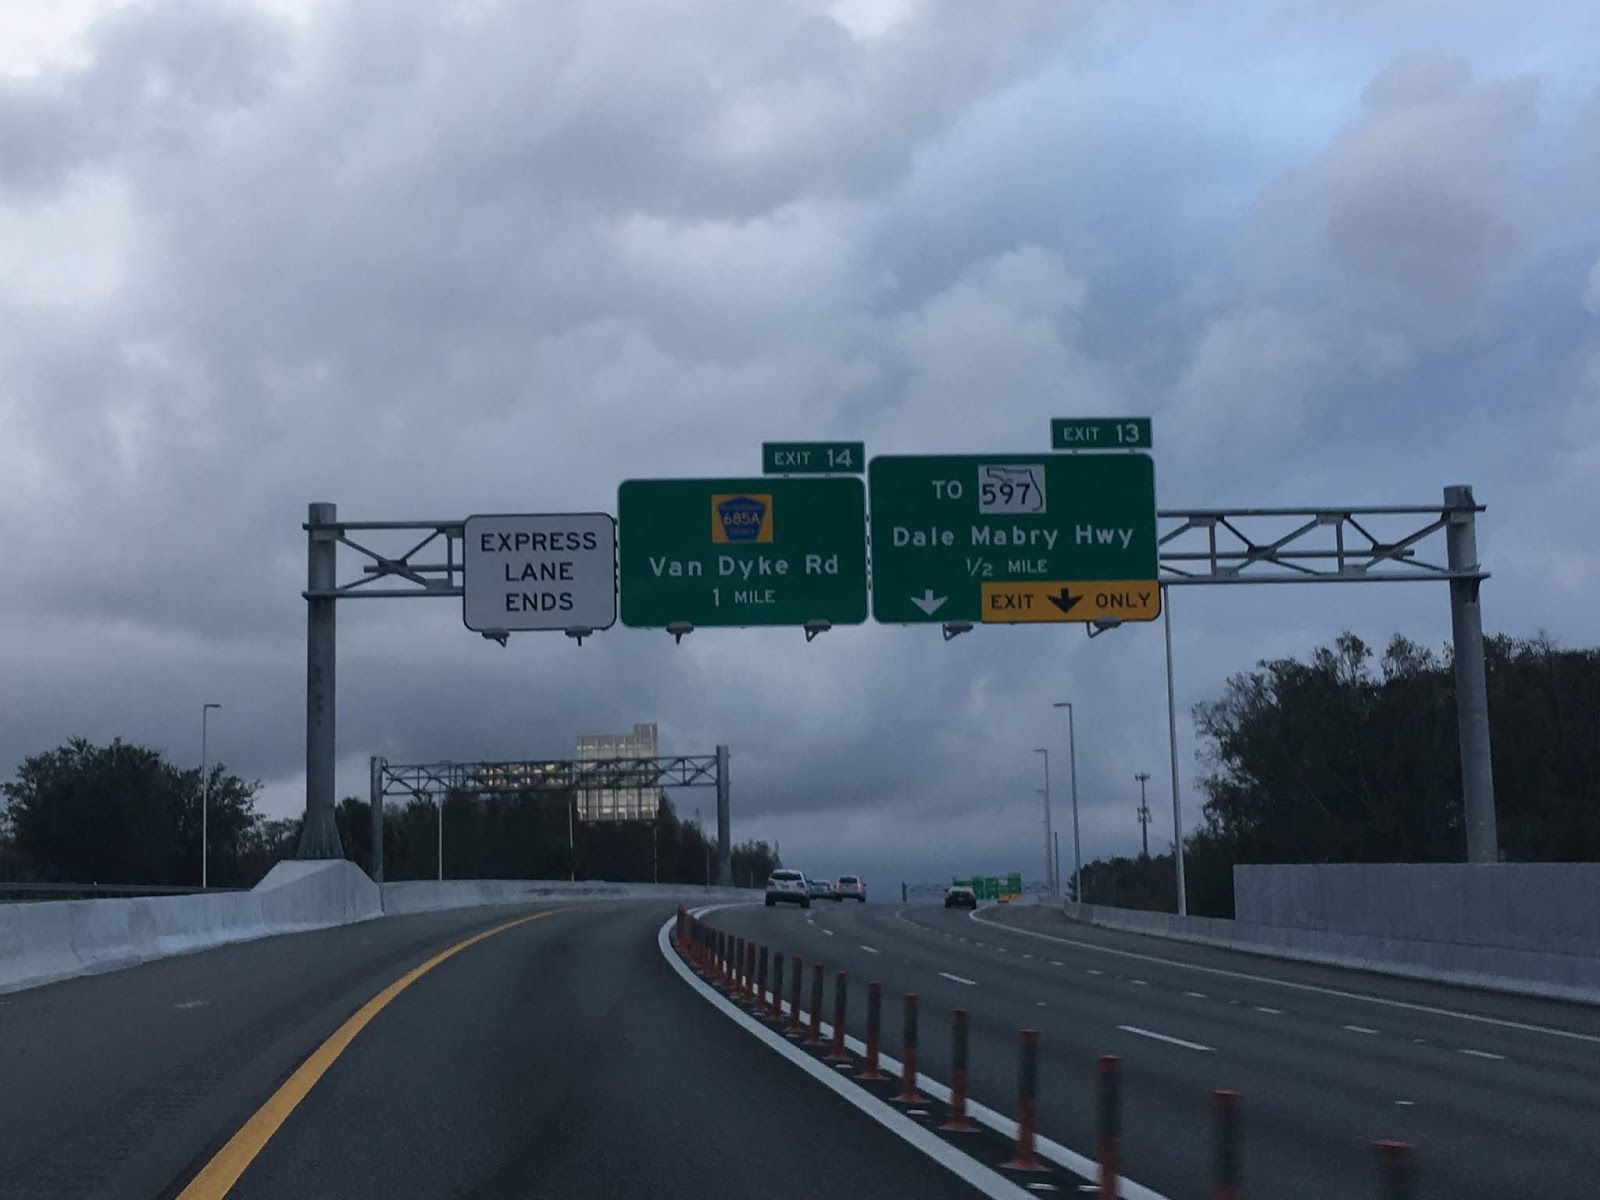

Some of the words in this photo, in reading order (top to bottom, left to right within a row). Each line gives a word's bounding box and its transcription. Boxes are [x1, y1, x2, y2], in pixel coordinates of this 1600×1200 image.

[1063, 427, 1100, 441] EXIT
[1116, 424, 1140, 443] 13
[774, 452, 811, 465] EXIT
[827, 449, 852, 467] 14
[932, 480, 963, 499] TO
[982, 483, 1031, 506] 597
[723, 511, 761, 526] 685A
[481, 531, 597, 552] EXPRESS
[893, 526, 955, 547] Dale
[971, 525, 1059, 550] Mabry
[1075, 524, 1134, 549] Hwy
[505, 561, 574, 581] LANE
[649, 556, 702, 577] Van
[718, 555, 789, 581] Dyke
[805, 554, 839, 576] Rd
[1008, 559, 1048, 573] MILE
[505, 592, 574, 612] ENDS
[713, 588, 720, 606] 1
[734, 590, 775, 604] MILE
[991, 594, 1034, 610] EXIT
[1095, 592, 1151, 608] ONLY
